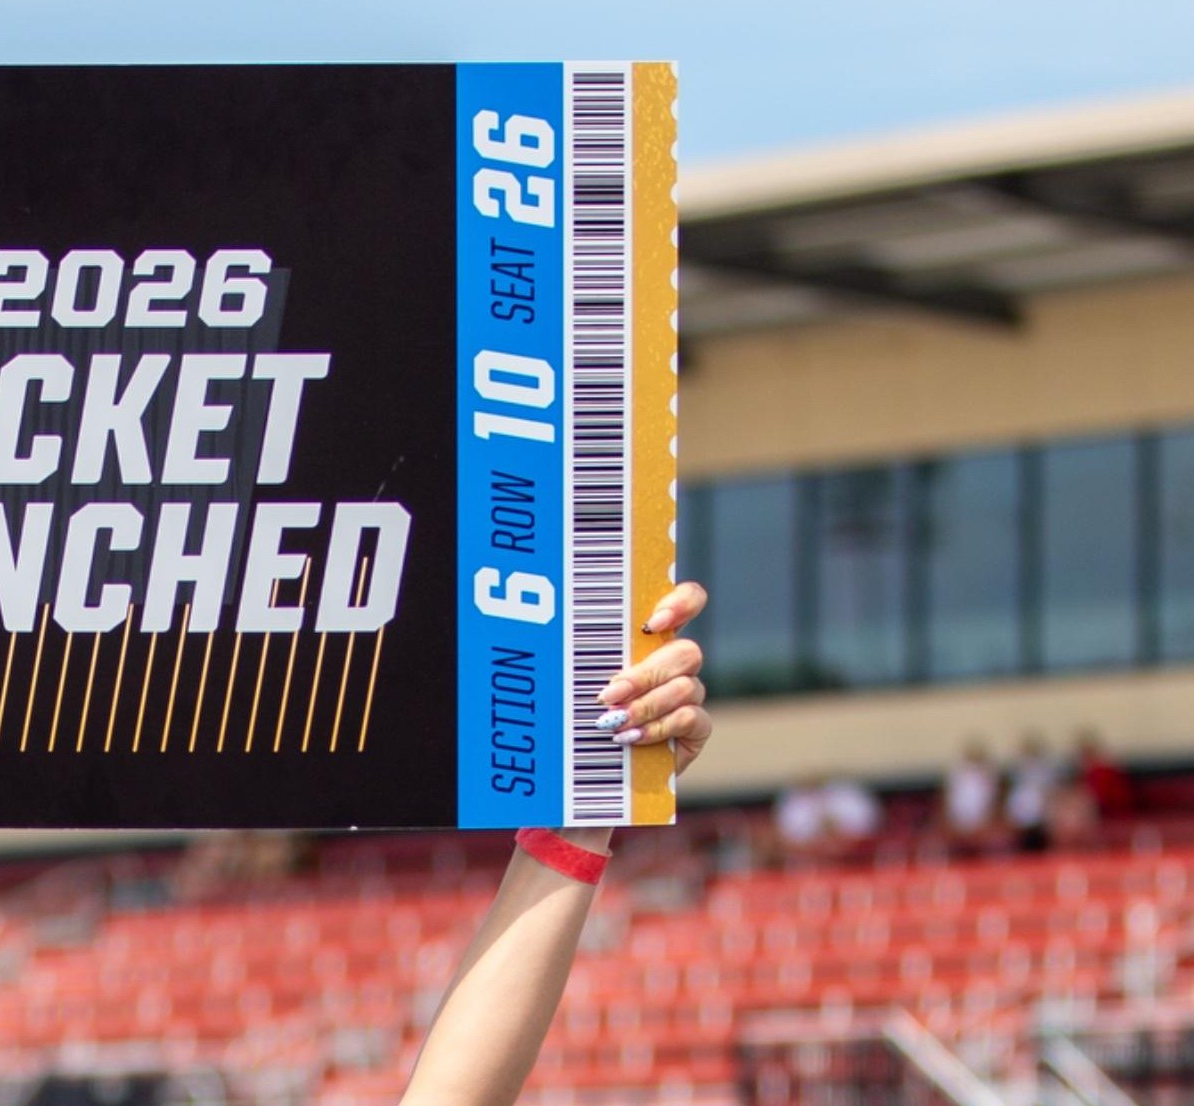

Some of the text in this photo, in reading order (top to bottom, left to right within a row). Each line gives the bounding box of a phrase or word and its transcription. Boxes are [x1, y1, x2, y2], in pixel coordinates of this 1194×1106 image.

[472, 109, 555, 797] SECTION 6 ROW 10 SEAT 26
